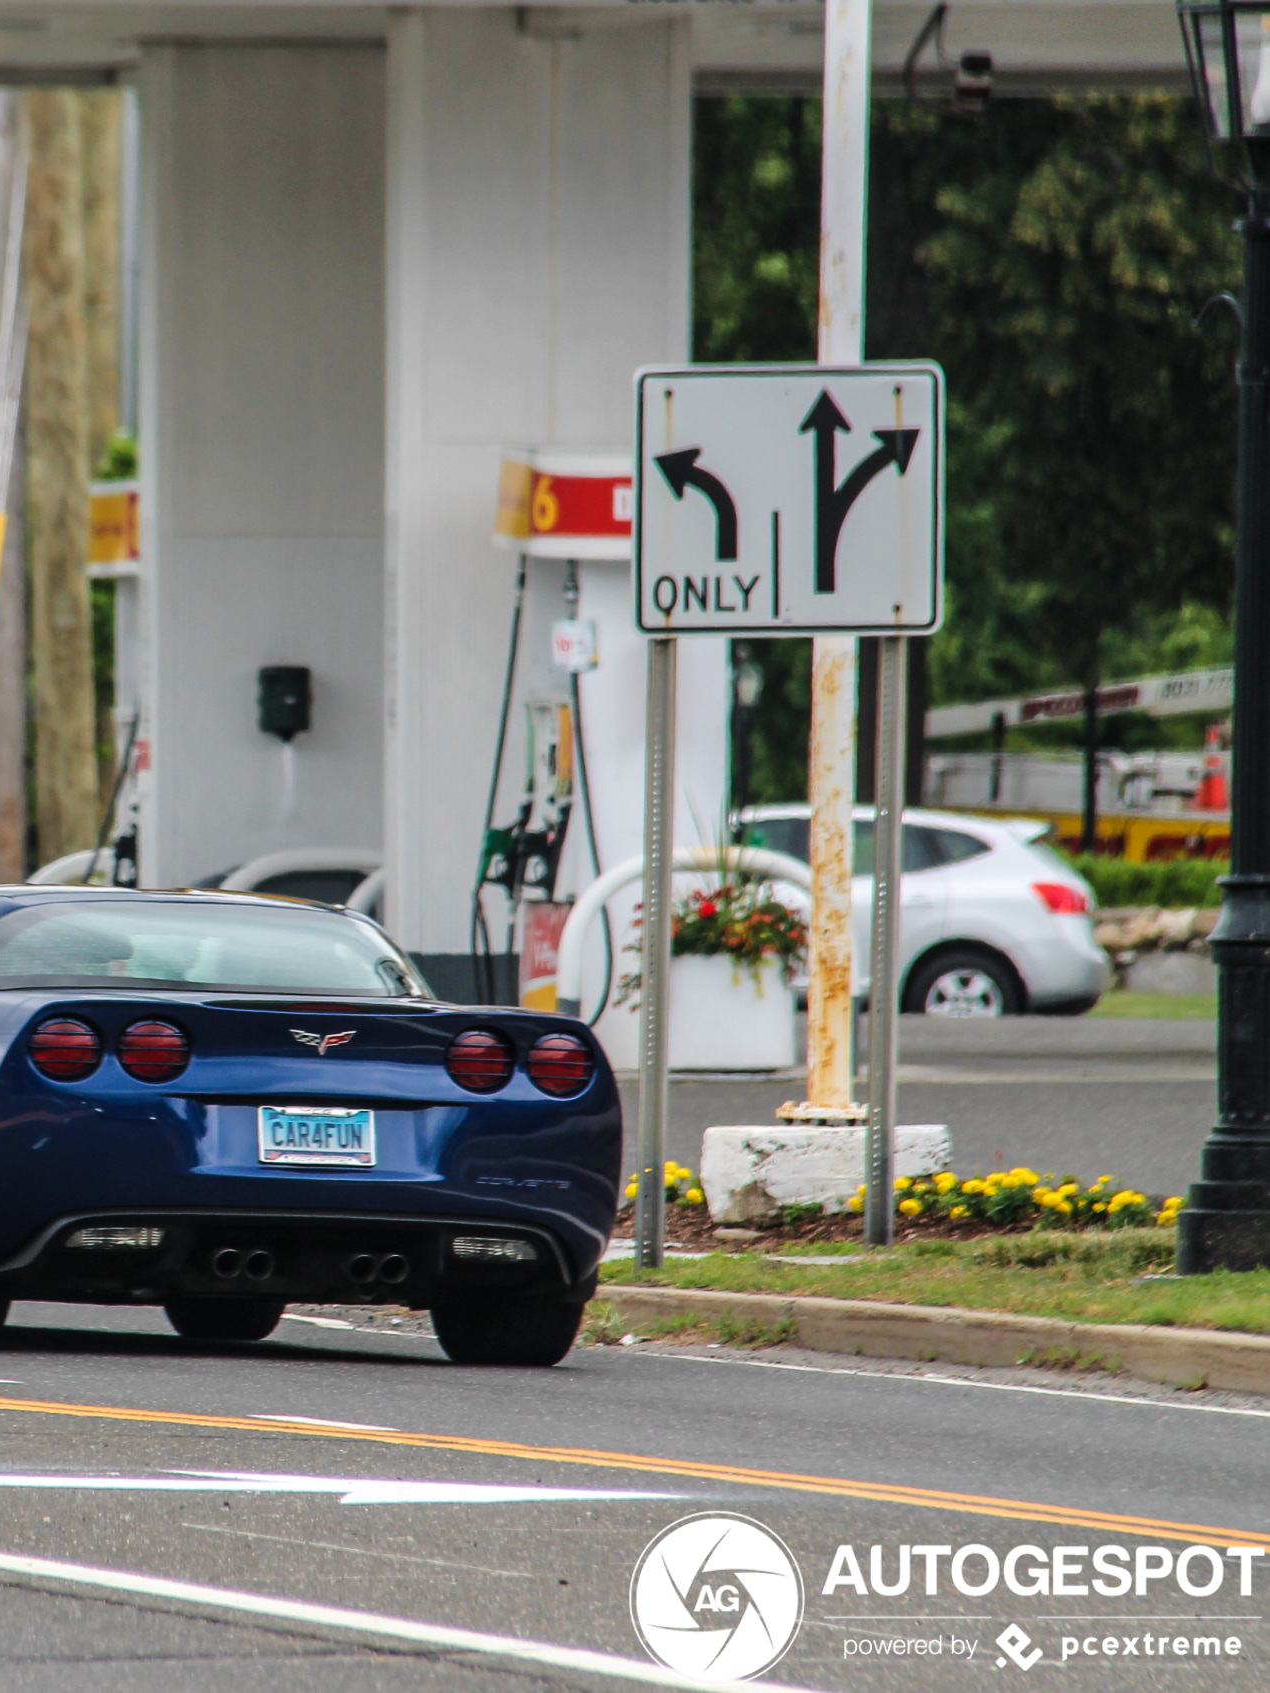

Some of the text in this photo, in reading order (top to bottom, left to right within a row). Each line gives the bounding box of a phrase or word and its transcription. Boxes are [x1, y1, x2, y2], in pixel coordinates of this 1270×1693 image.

[532, 475, 558, 532] 6
[653, 575, 760, 614] ONLY
[272, 1121, 362, 1149] CAR4FUN
